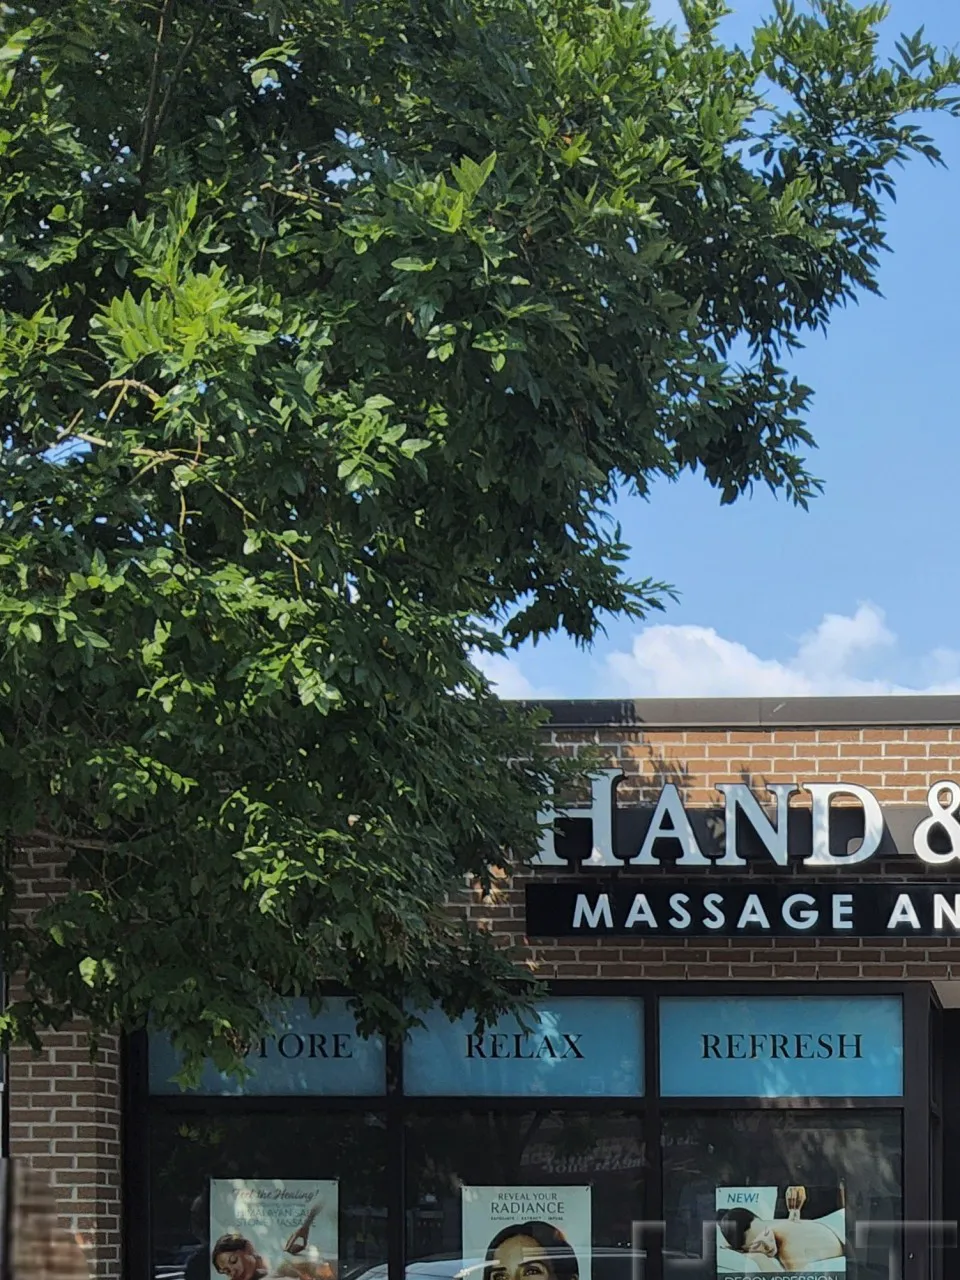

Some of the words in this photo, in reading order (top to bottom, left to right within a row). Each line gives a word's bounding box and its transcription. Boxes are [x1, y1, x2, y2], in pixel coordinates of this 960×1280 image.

[523, 768, 884, 866] HAND
[572, 893, 854, 930] MASSAGE
[465, 1033, 585, 1060] RELAX
[701, 1033, 863, 1060] REFRESH
[491, 1202, 565, 1214] RADIANCE
[498, 1192, 530, 1200] REVEAL
[533, 1192, 557, 1200] YOUR
[727, 1192, 760, 1203] NEW!
